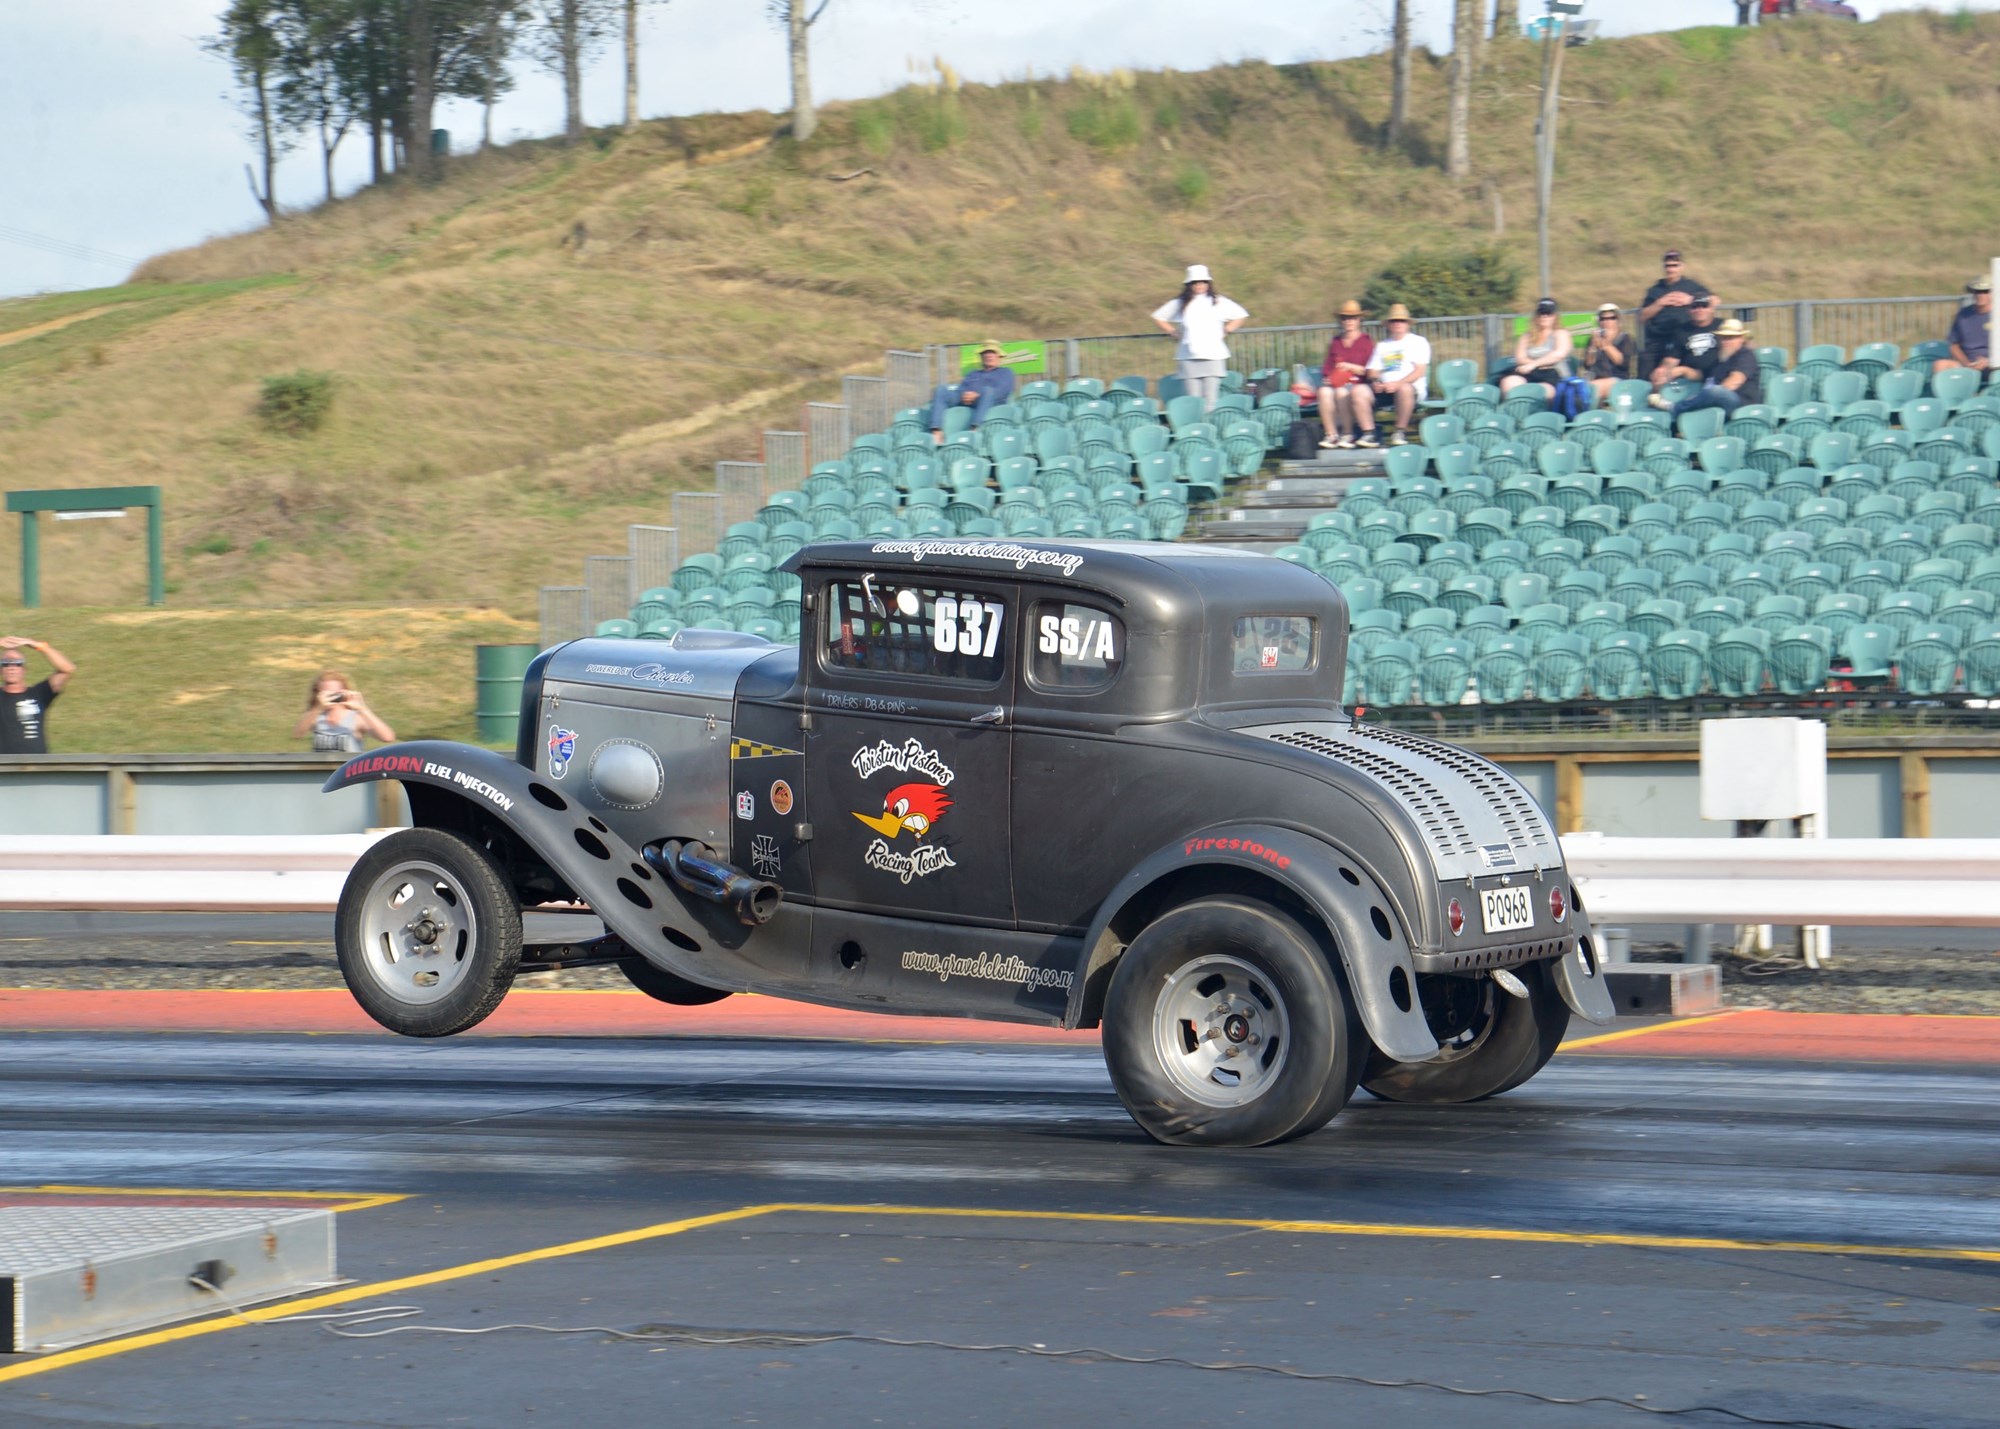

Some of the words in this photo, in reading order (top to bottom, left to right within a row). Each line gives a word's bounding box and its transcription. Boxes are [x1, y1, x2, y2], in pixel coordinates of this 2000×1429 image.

[934, 597, 1004, 658] 637
[1039, 615, 1115, 660] SS/A
[585, 664, 620, 675] POWERED
[620, 667, 633, 676] BY
[631, 663, 695, 687] Chrysler
[827, 694, 862, 709] DRIVERS:
[887, 699, 906, 714] PINS
[345, 756, 424, 779] HILBORN
[424, 762, 452, 780] FUEL
[454, 771, 514, 811] INJECTION
[852, 740, 902, 779] Twistin
[901, 738, 954, 786] Pistons
[865, 838, 914, 884] Racing
[911, 845, 957, 876] Team
[1184, 837, 1291, 870] Firestone
[1486, 891, 1529, 928] PQ968
